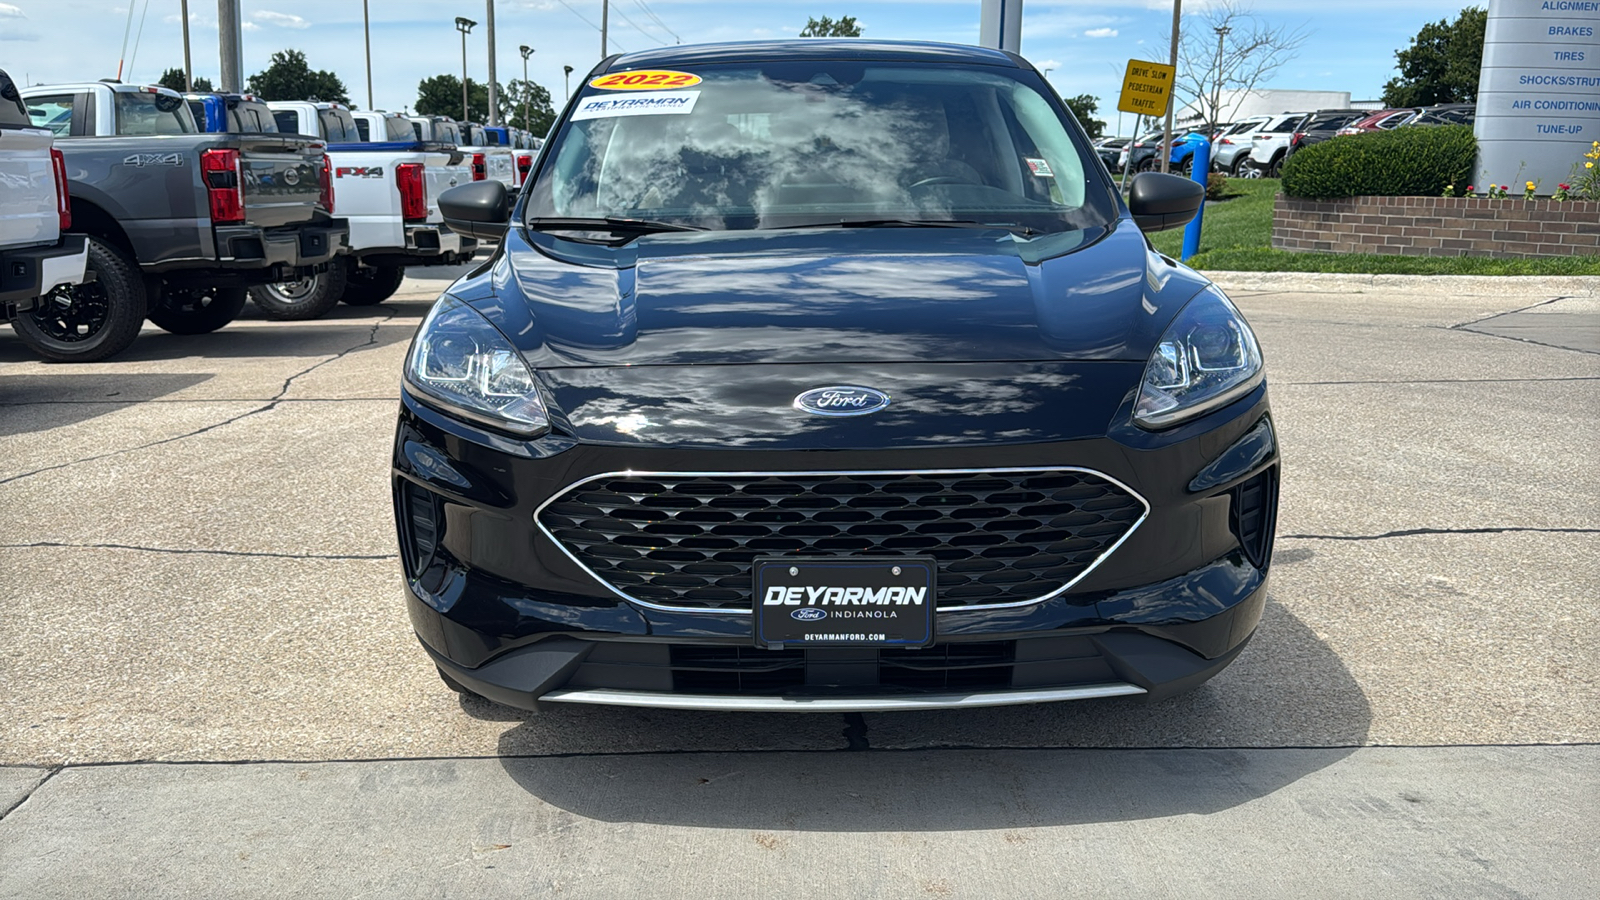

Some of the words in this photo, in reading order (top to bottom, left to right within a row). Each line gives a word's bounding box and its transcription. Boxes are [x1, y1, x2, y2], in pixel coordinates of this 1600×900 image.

[1541, 1, 1600, 12] ALIGNMEN
[1548, 26, 1593, 36] BRAKES
[1553, 51, 1585, 61] TIRES
[1132, 68, 1149, 78] DRIVE
[1151, 70, 1167, 79] SLOW
[599, 74, 694, 86] 2022
[1128, 82, 1163, 94] PEDESTRIAN
[584, 97, 690, 109] DEYARMAN
[1132, 98, 1155, 109] TRAFFIC
[1512, 100, 1531, 109] AIR
[1536, 124, 1583, 134] TUNE-UP
[335, 167, 384, 178] FX4
[816, 390, 867, 408] Ford
[763, 586, 927, 606] DEYARMAN
[797, 609, 820, 620] Ford
[830, 610, 898, 619] INDIANOLA
[804, 633, 886, 641] DEYARMANFORD.COM
